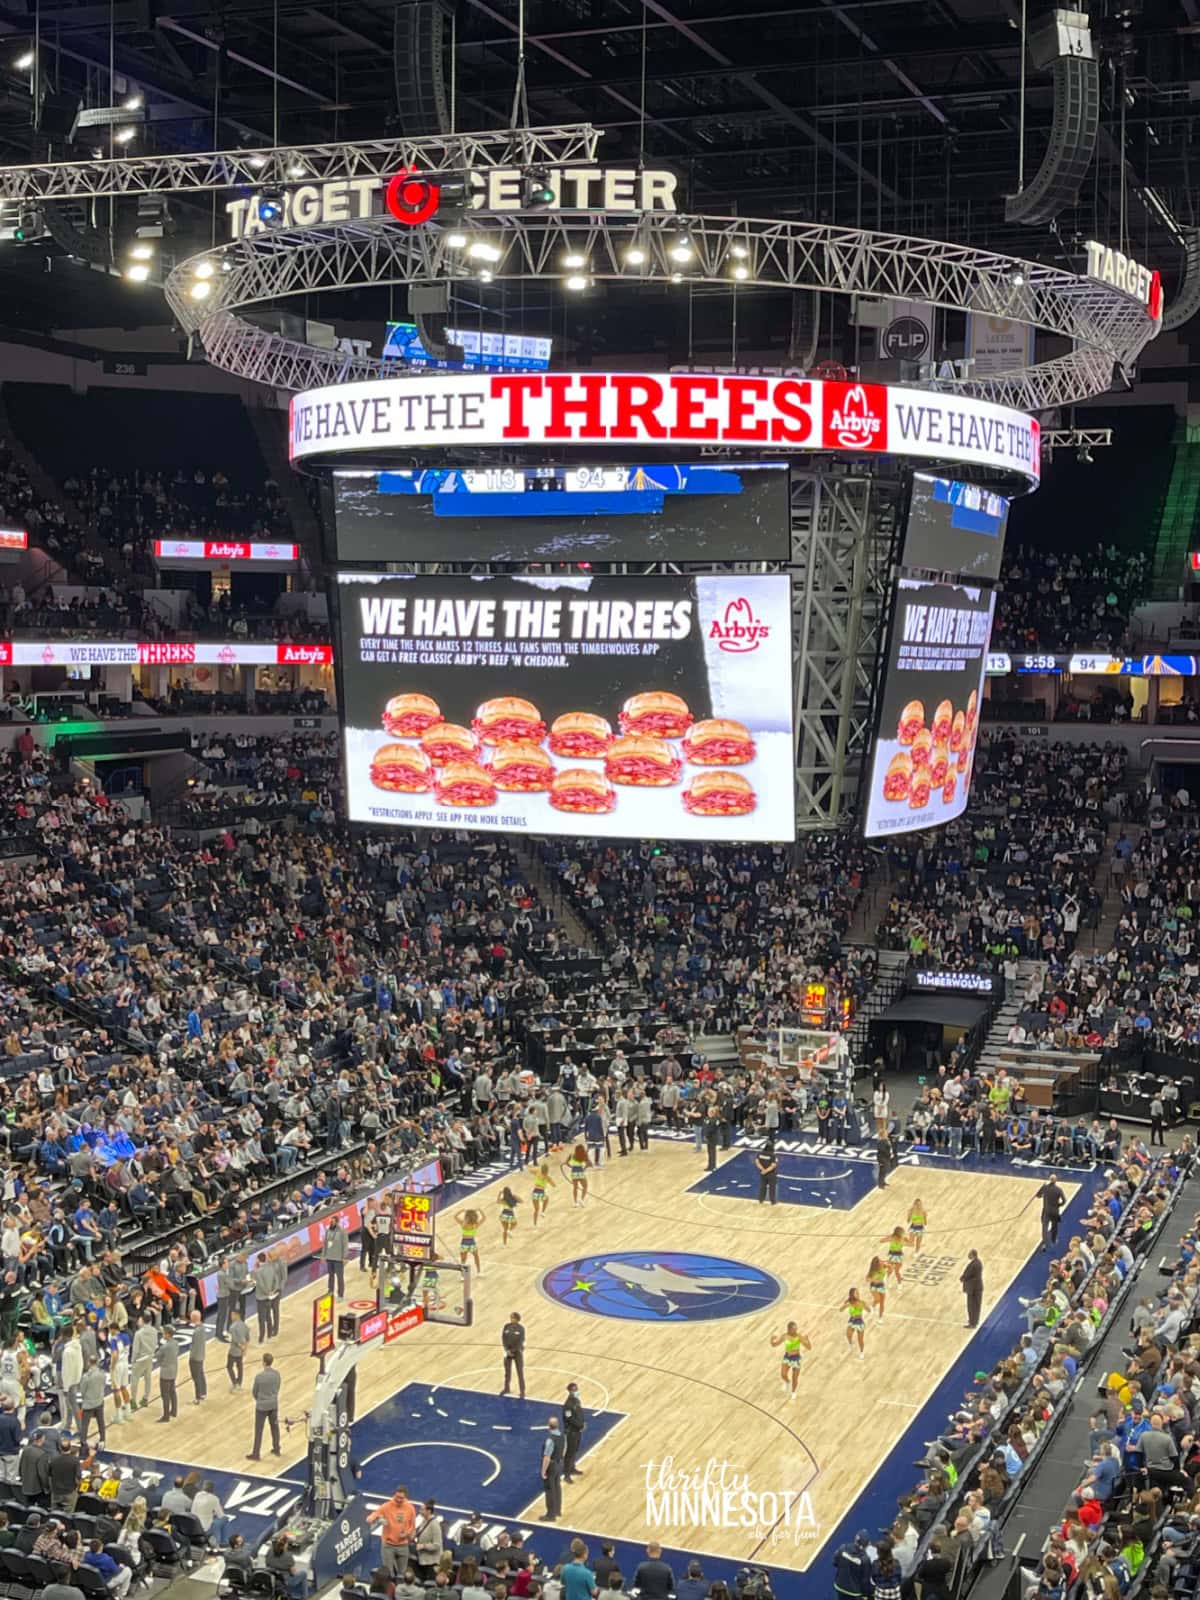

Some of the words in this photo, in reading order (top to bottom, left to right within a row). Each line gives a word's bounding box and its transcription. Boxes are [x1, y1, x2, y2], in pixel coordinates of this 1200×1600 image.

[226, 180, 377, 238] TAGET
[1083, 240, 1152, 304] TARGET
[888, 333, 924, 347] FLIP
[294, 405, 313, 442] WE
[315, 397, 391, 441] HAVE
[400, 392, 486, 431] THE
[490, 375, 813, 442] THREES
[829, 409, 881, 437] Arby's
[895, 403, 943, 442] WE
[946, 411, 1003, 456] HAVE
[1004, 420, 1032, 464] THE
[485, 469, 516, 490] 113
[576, 467, 606, 489] 94
[360, 598, 407, 636] WE
[413, 599, 497, 637] HAVE
[503, 600, 562, 639] THE
[569, 600, 692, 640] THREES
[903, 604, 927, 642] WE
[709, 620, 770, 642] Arby's
[70, 648, 87, 661] WE
[88, 648, 117, 661] HAVE
[117, 648, 136, 661] THE
[137, 643, 195, 664] THREES
[284, 648, 325, 664] Arby's
[360, 638, 381, 649] EVERY
[382, 638, 398, 650] TIME
[400, 639, 414, 650] THE
[416, 640, 434, 651] PACK
[436, 640, 460, 652] MAKES
[463, 641, 473, 652] 12
[475, 641, 502, 653] THREES
[504, 642, 518, 653] ALL
[520, 642, 540, 654] FANS
[542, 643, 562, 654] WITH
[564, 643, 579, 654] THE
[581, 643, 639, 655] TIMBERWOLVES
[642, 643, 660, 655] APP
[361, 651, 375, 662] CAN
[377, 651, 389, 662] GET
[391, 652, 398, 662] A
[399, 652, 417, 663] FREE
[420, 653, 453, 664] CLASSIC
[454, 654, 487, 665] ARBY'S
[489, 655, 509, 666] BEEF
[1024, 655, 1057, 671] 5:58
[1079, 659, 1102, 672] 94
[1028, 727, 1041, 735] 101
[917, 973, 993, 991] TIMBERWOLVES
[335, 1527, 361, 1555] TARGET
[337, 1537, 363, 1566] CENTER
